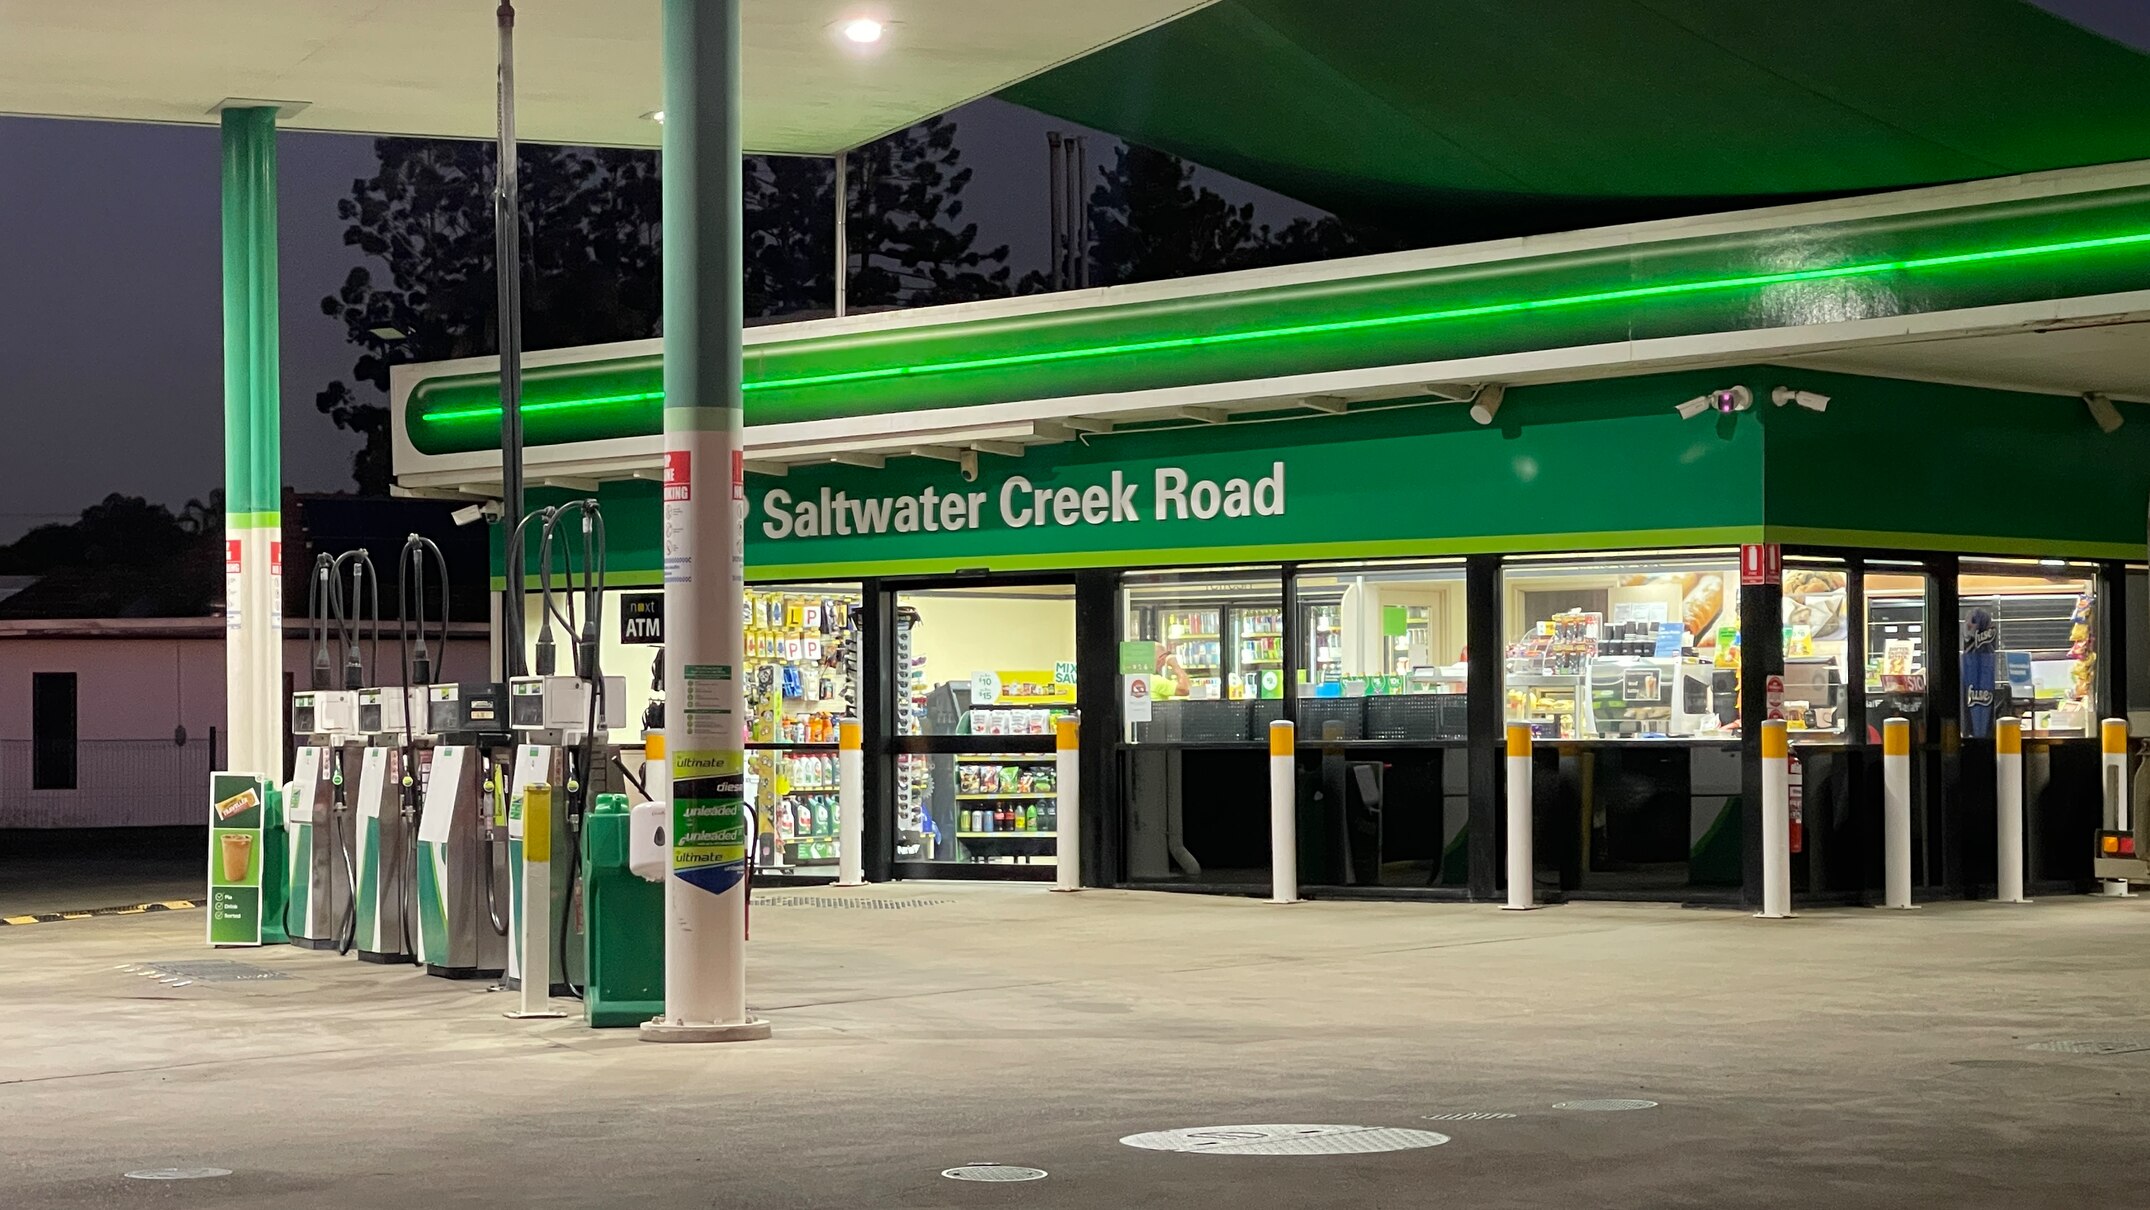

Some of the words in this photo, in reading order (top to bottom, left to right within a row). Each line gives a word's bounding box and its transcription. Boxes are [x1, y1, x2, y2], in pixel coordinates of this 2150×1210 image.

[762, 485, 986, 539] Saltwater
[1000, 469, 1140, 529] Creek
[1155, 461, 1285, 521] Road
[790, 609, 799, 625] L
[807, 609, 817, 625] P
[625, 618, 660, 637] ATM
[1975, 627, 1994, 648] fuse
[789, 643, 798, 657] P
[808, 642, 817, 656] P
[1968, 684, 1991, 706] fuse
[677, 757, 724, 768] ultimate
[716, 782, 743, 792] dies
[686, 804, 738, 816] unleaded
[686, 830, 738, 842] unleaded
[676, 851, 723, 863] ultimate
